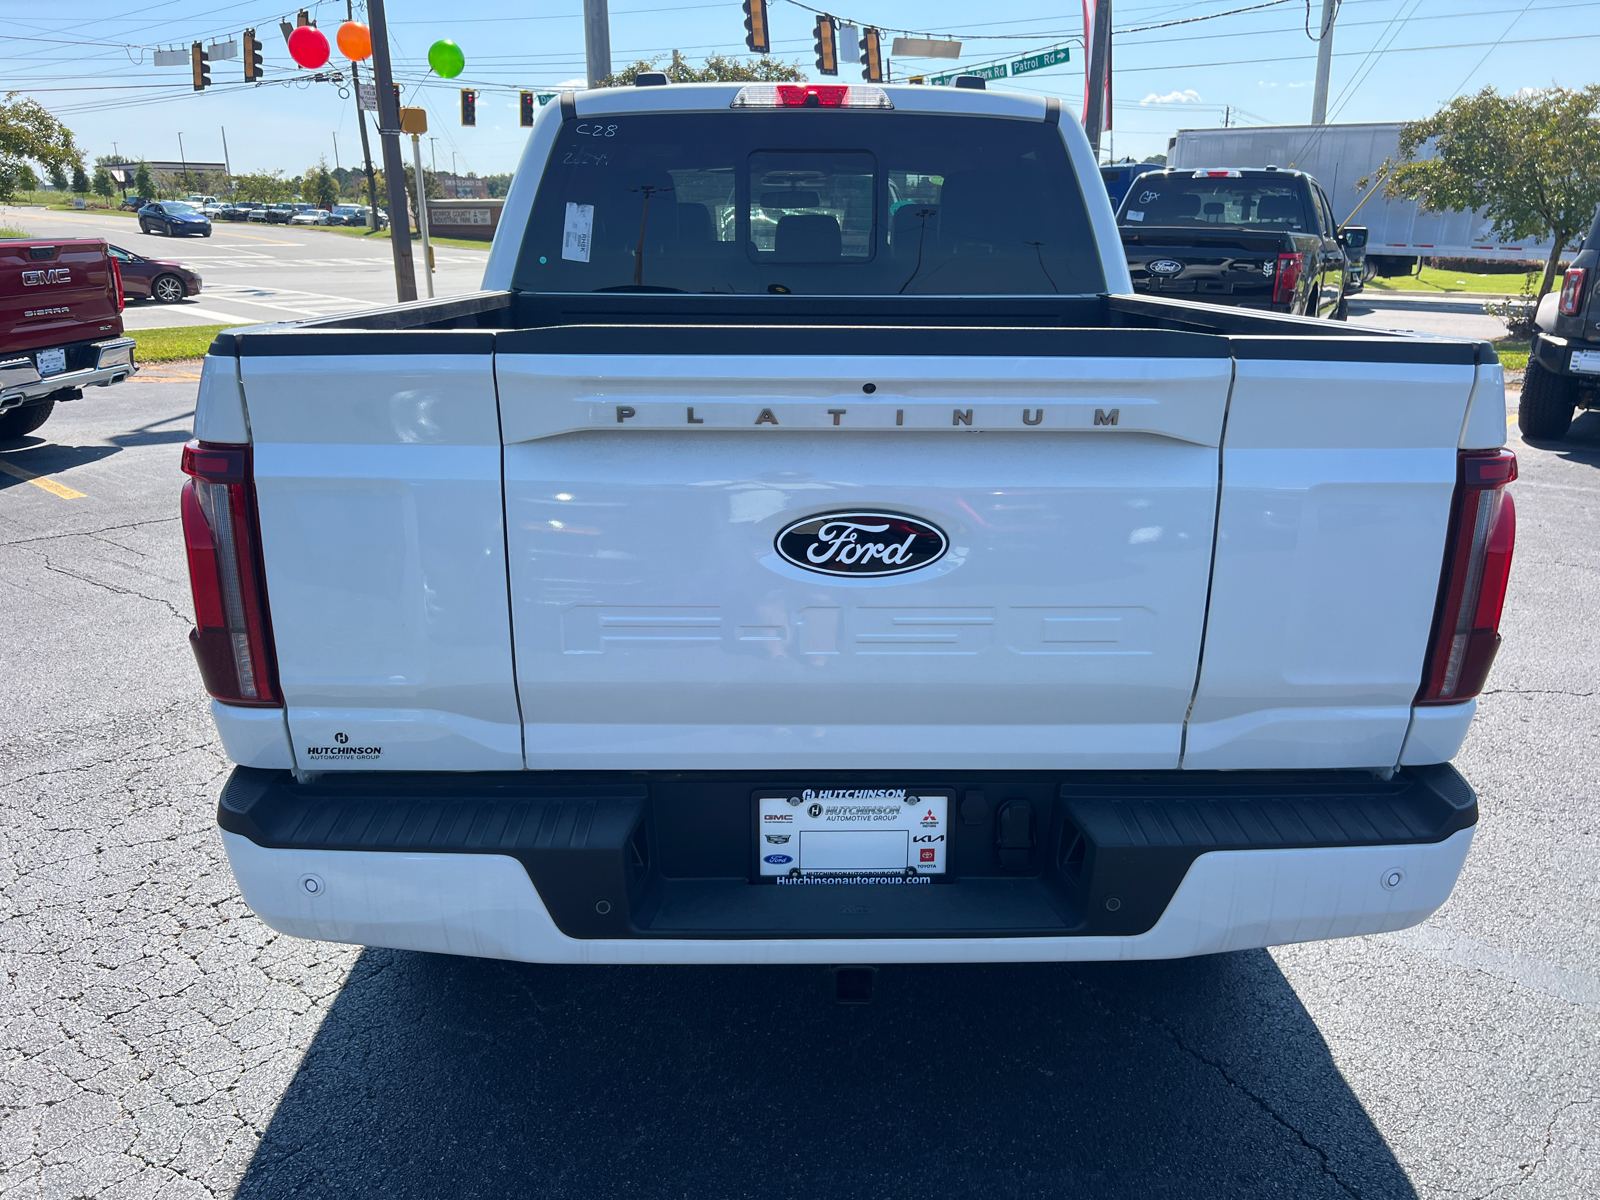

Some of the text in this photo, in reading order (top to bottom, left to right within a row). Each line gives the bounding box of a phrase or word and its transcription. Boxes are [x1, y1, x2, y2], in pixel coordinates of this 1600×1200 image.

[1014, 53, 1055, 72] Patrol Rd
[994, 66, 1005, 77] Rd
[576, 124, 618, 137] C28
[452, 210, 471, 218] COUNTY
[1154, 262, 1176, 272] Ford
[22, 268, 71, 286] GMC
[24, 306, 70, 317] SIERRA
[616, 406, 1119, 425] PLATINUM
[806, 521, 914, 566] Ford
[307, 747, 382, 755] HUTCHINSON
[818, 789, 906, 800] HUTCHINSON
[825, 806, 901, 815] HUTCHINSON
[913, 835, 944, 843] KIA
[769, 855, 787, 863] Ford
[776, 876, 931, 885] Hutchinsonautogroup.com
